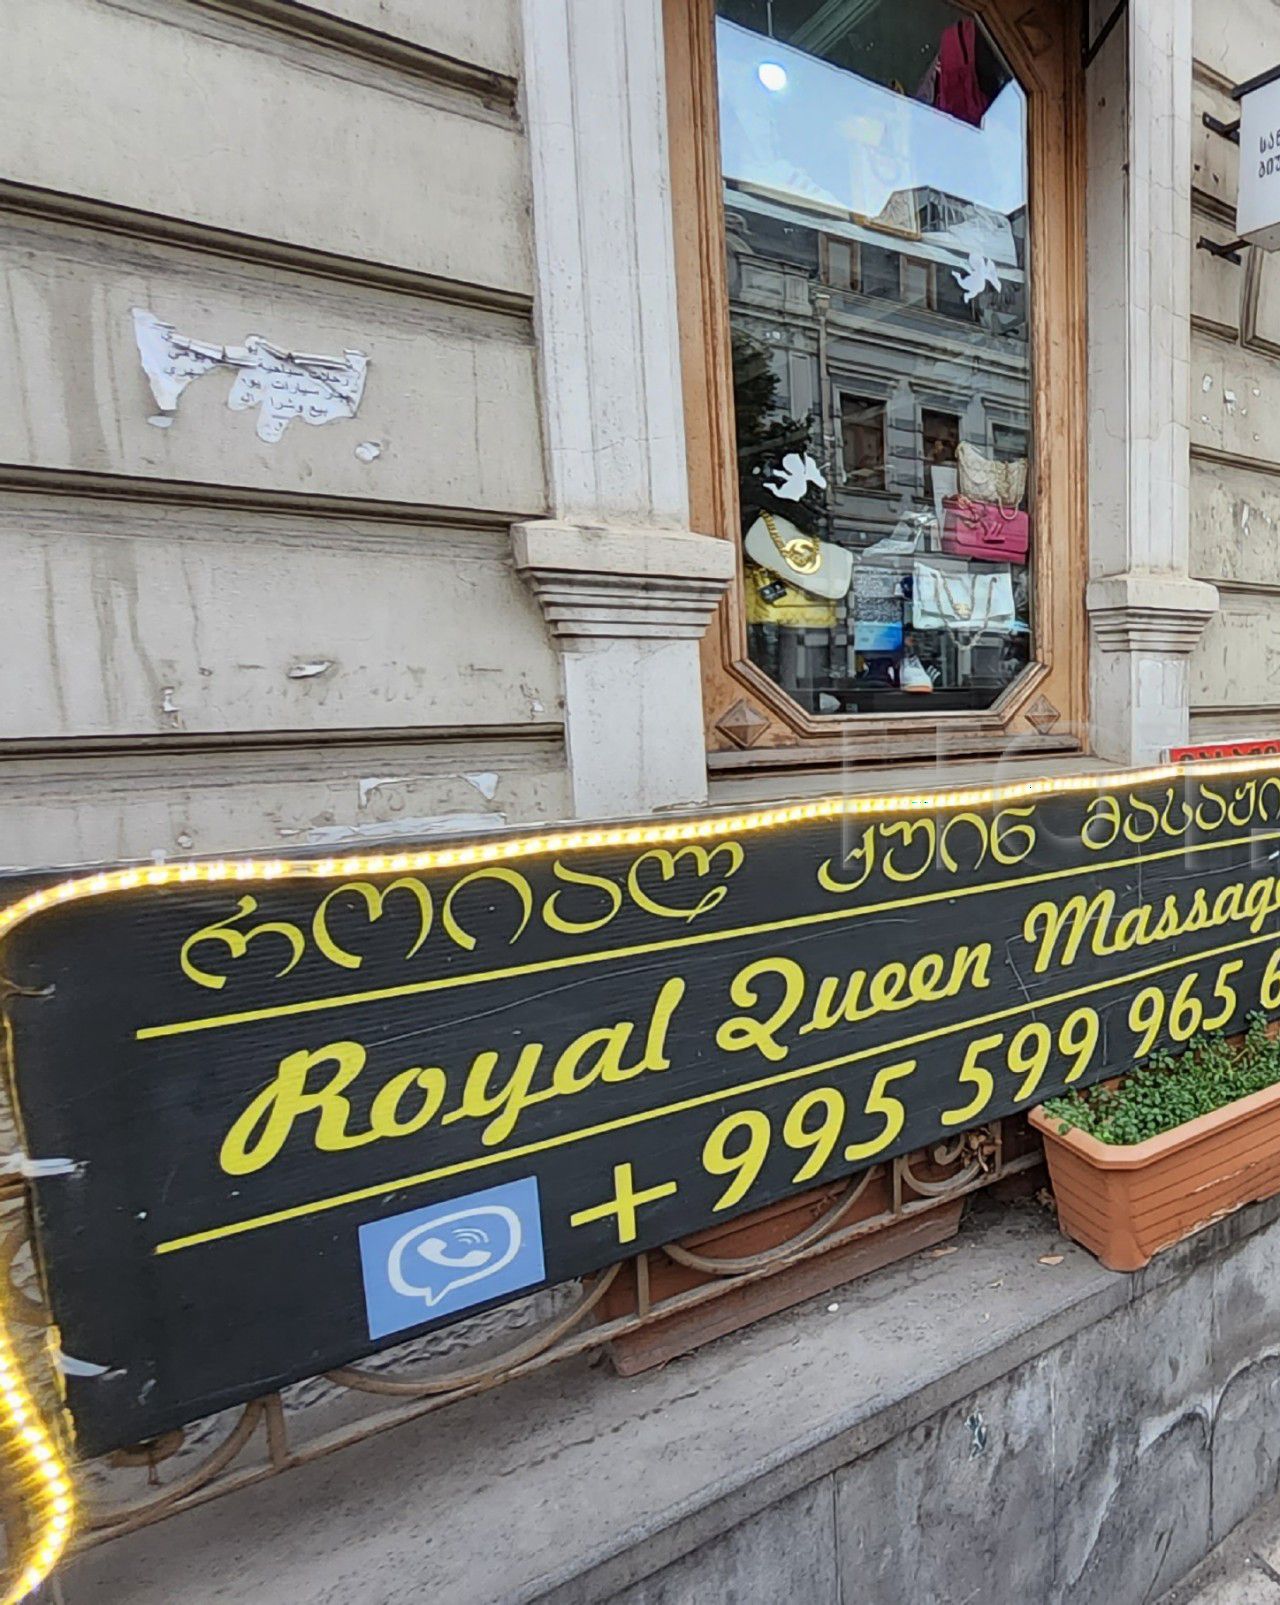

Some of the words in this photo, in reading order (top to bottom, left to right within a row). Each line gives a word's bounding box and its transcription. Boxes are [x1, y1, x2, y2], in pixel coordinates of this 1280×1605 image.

[179, 840, 746, 990] როიალ
[219, 977, 686, 1177] Royal
[714, 942, 993, 1062] Queen
[940, 1006, 1101, 1126] 599
[1127, 959, 1245, 1059] 965
